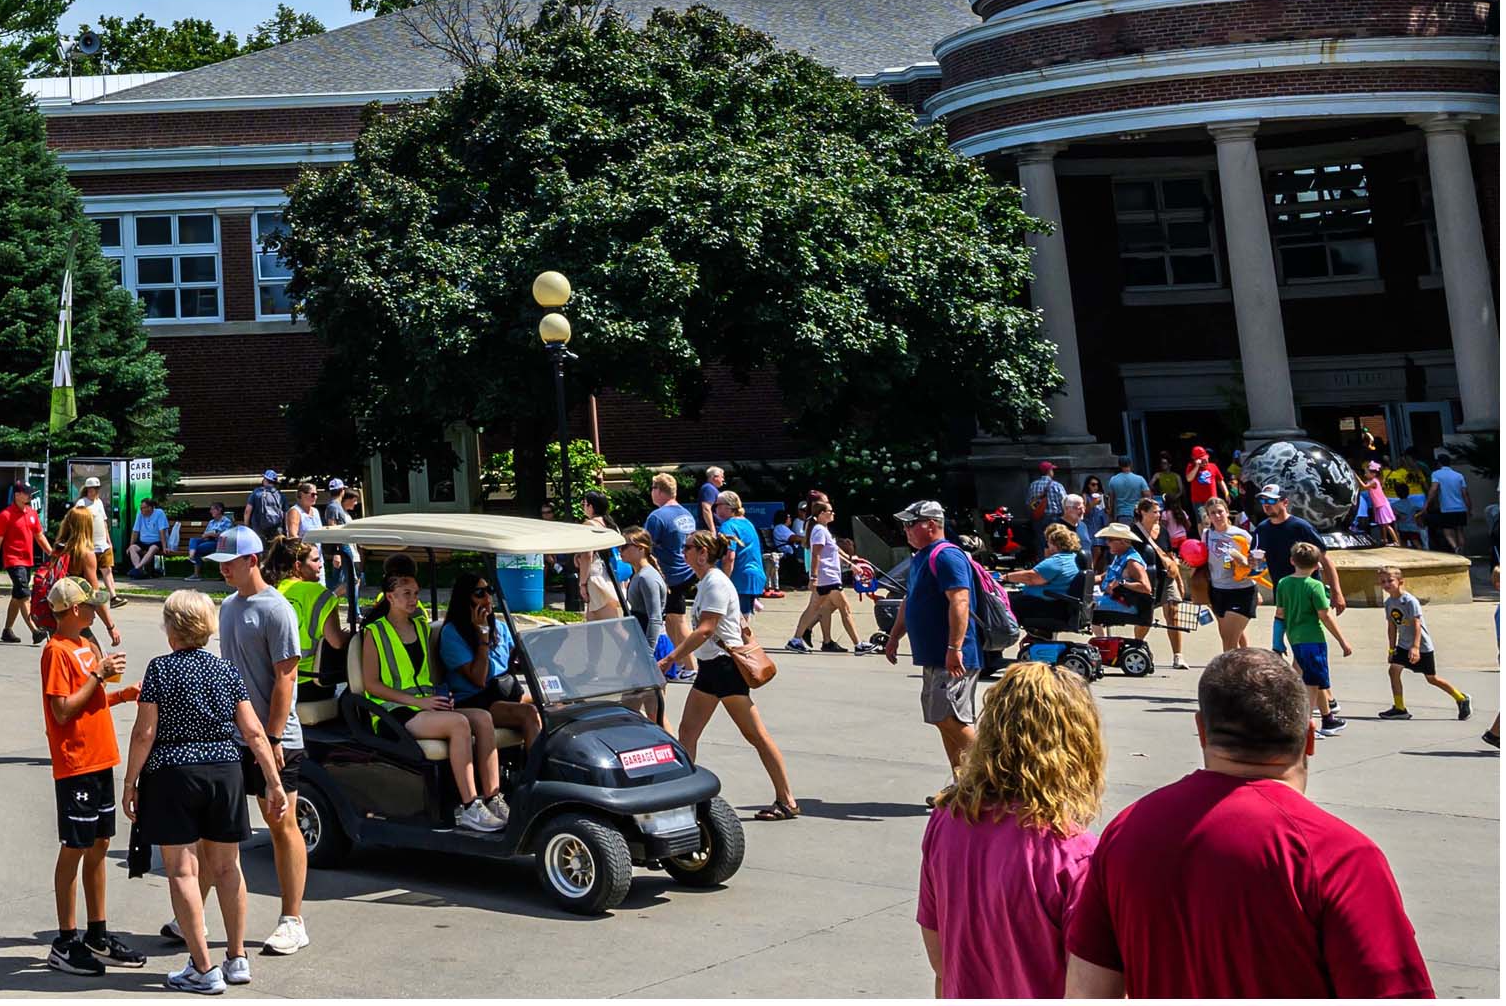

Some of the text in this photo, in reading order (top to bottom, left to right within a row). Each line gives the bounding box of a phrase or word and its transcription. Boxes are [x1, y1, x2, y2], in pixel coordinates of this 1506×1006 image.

[130, 462, 151, 470] CARE
[130, 472, 151, 481] CUBE
[623, 751, 654, 766] GARBAGE
